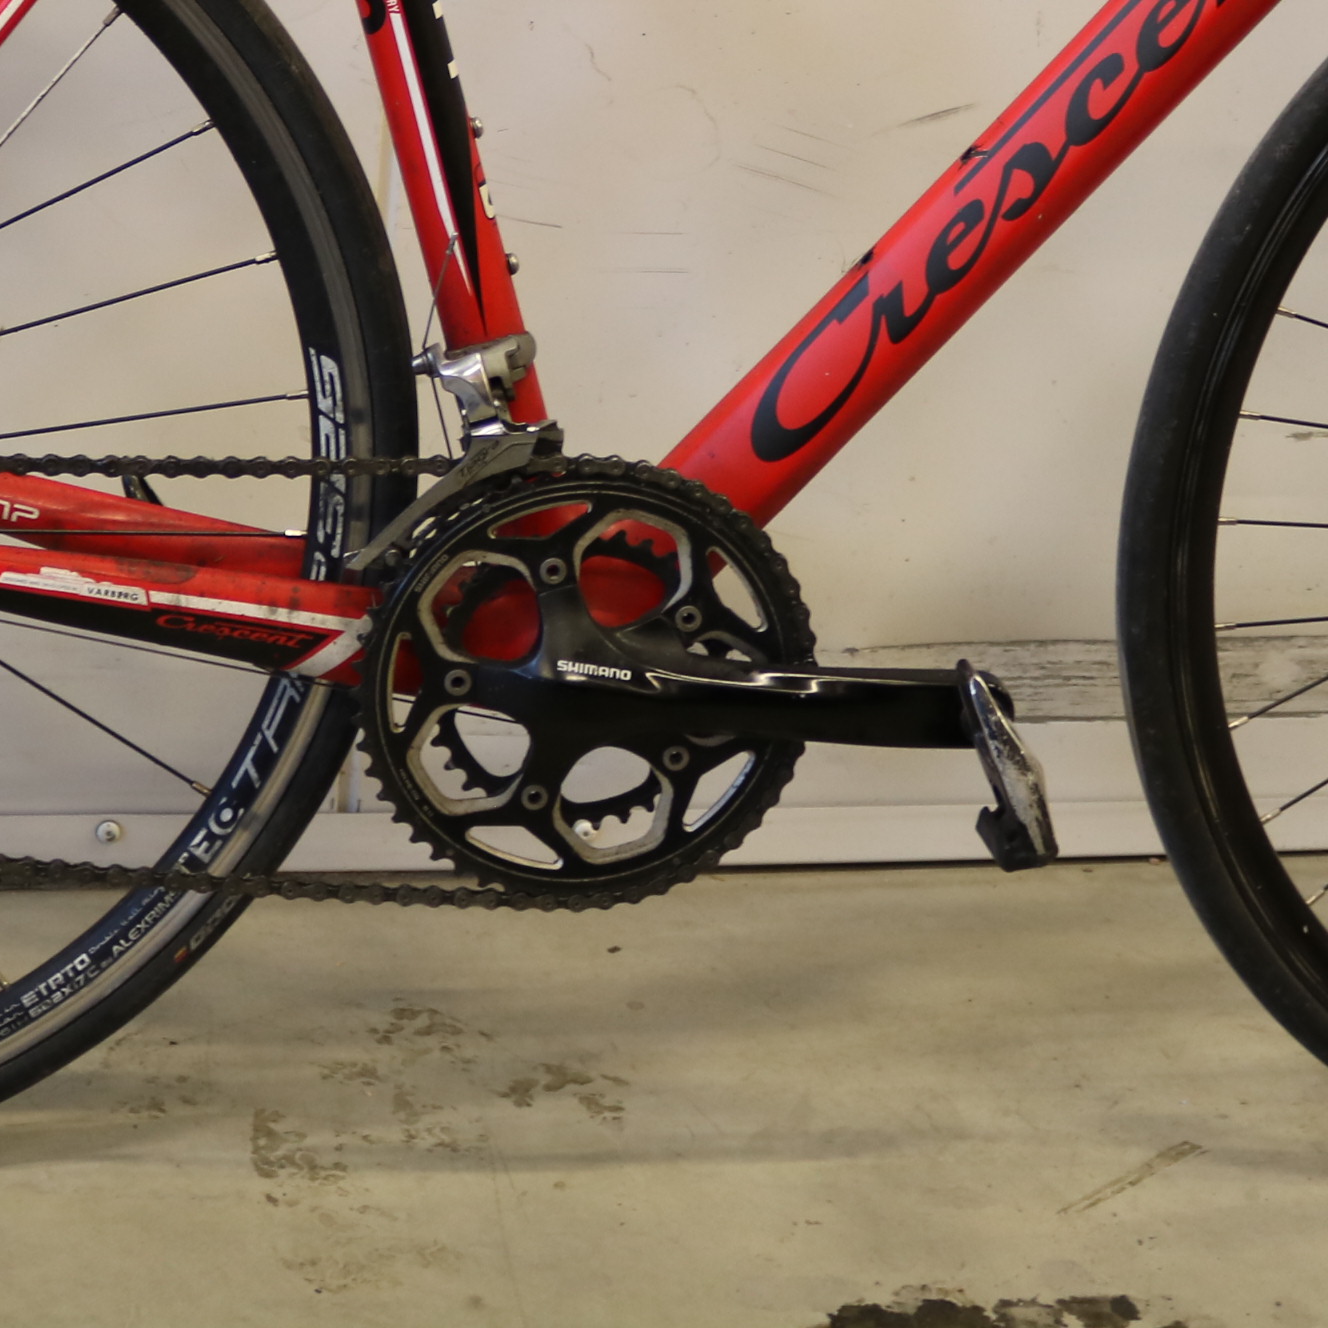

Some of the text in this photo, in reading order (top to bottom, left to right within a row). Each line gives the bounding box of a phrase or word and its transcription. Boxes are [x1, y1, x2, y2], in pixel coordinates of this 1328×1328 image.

[86, 586, 140, 602] VARBERG
[156, 614, 314, 649] Crescent
[556, 659, 632, 681] SHIMANO
